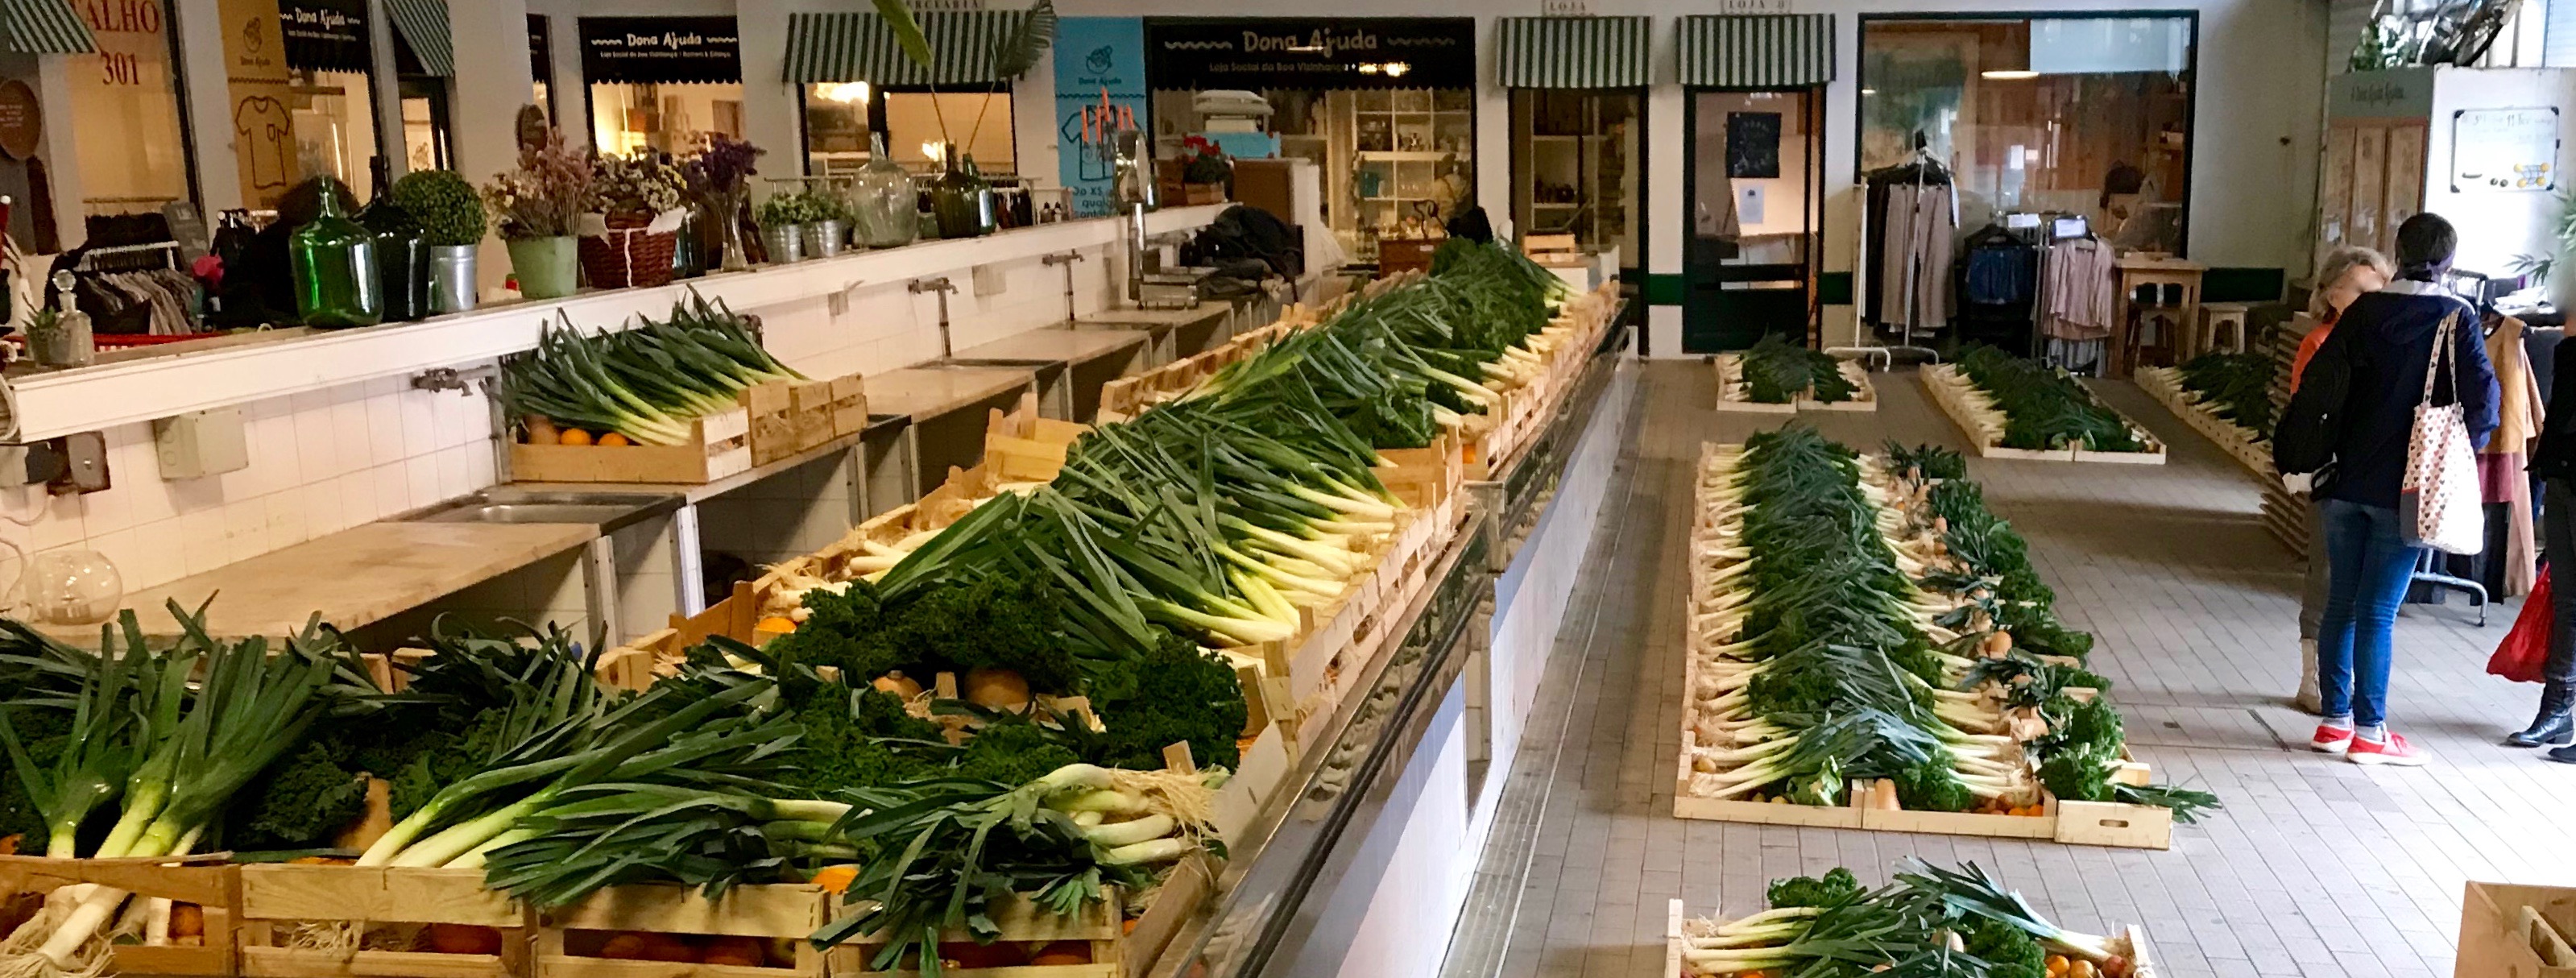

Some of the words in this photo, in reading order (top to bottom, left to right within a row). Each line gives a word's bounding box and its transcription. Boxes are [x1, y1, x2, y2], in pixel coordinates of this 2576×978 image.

[295, 6, 317, 23] Dona
[320, 9, 346, 31] Ajuda
[627, 33, 658, 47] Dona
[663, 31, 702, 50] Ajuda
[1243, 31, 1298, 52] Dona
[1309, 28, 1377, 58] Ajuda
[101, 51, 139, 85] 301
